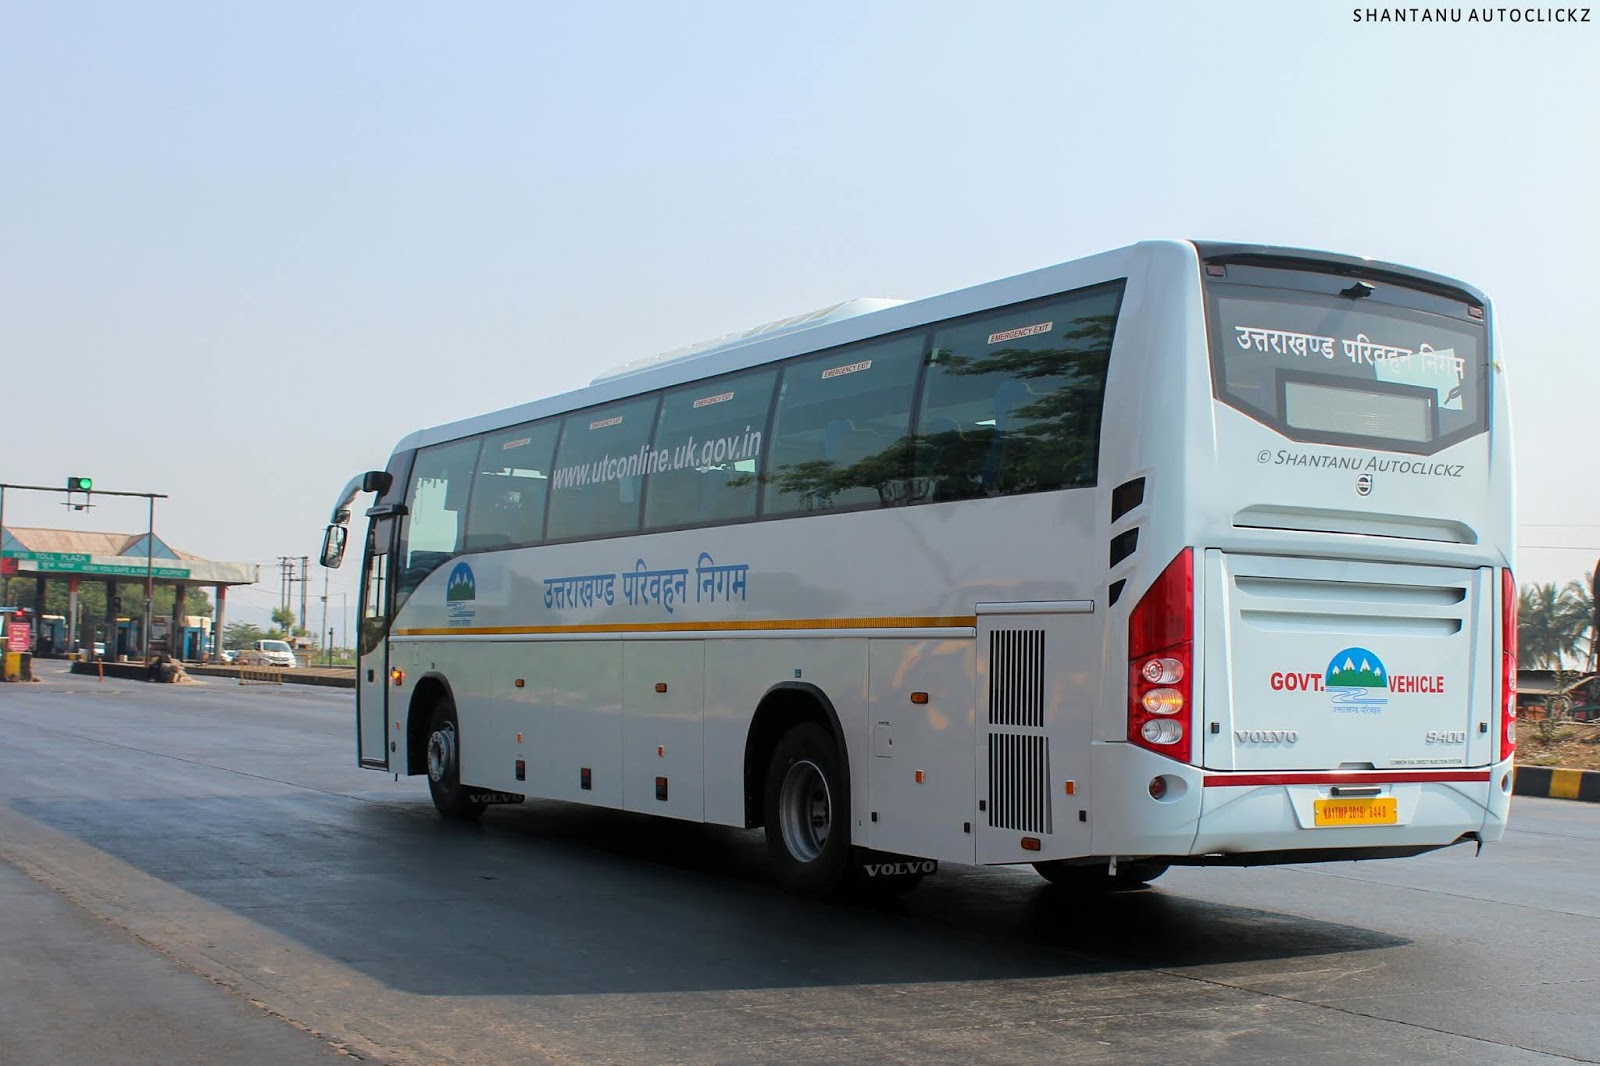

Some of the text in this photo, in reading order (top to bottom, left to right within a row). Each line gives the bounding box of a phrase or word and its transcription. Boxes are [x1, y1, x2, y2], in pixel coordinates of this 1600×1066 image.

[990, 323, 1050, 343] EMERGENCY EXIT
[1235, 326, 1465, 379] उत्तराखण्ड परिवहन निगम
[823, 361, 870, 378] EMERGENCY EXIT
[552, 425, 762, 490] www.utconline.uk.gov.in
[60, 554, 87, 562] PLAZA
[543, 551, 749, 614] उत्तराखण्ड परिवहन निगम
[1270, 672, 1325, 692] GOVT.
[1388, 675, 1444, 693] VEHICLE
[1235, 730, 1298, 744] VOLVO
[469, 793, 523, 803] VOLVO
[863, 860, 935, 877] VOLVO
